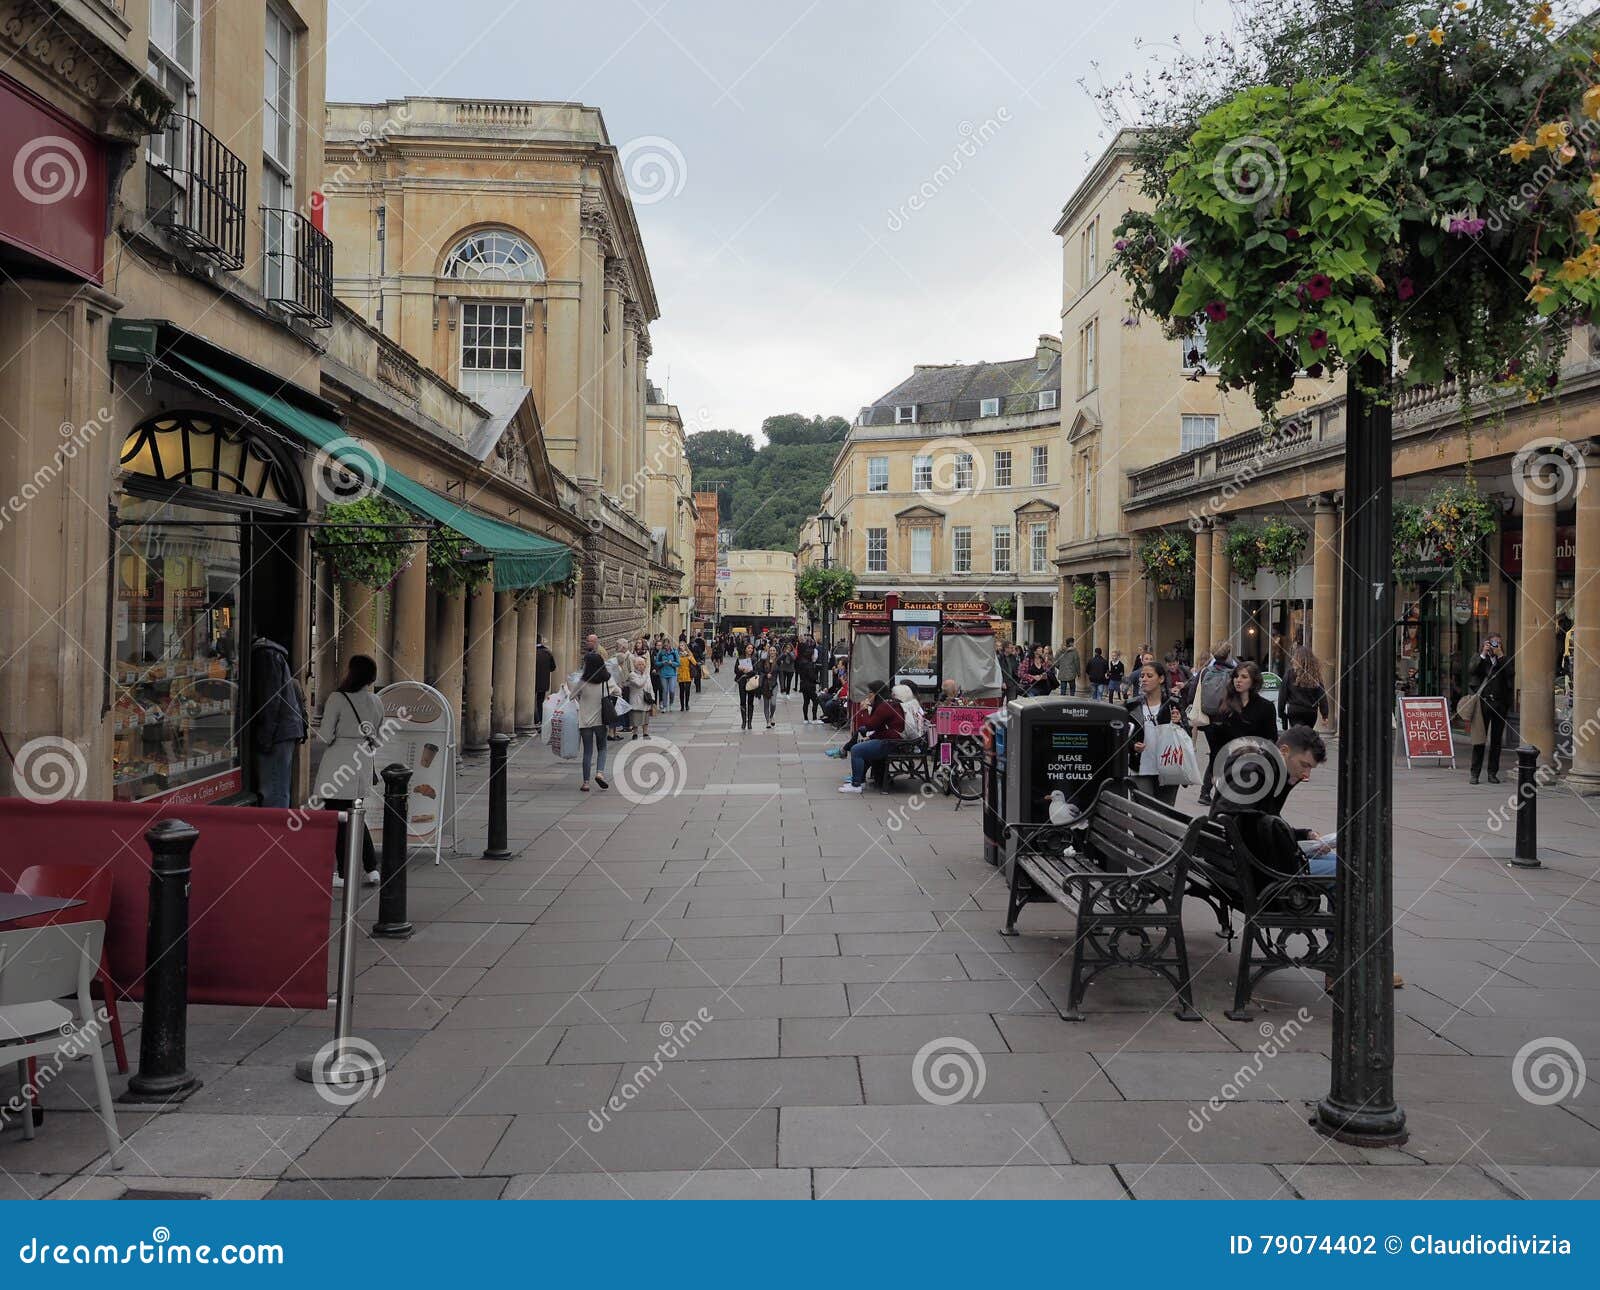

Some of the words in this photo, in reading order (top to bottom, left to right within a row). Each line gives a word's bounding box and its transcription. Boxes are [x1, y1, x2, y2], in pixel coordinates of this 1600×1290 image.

[1373, 583, 1384, 600] 7
[1410, 720, 1442, 730] HALF
[1409, 731, 1447, 741] PRICE
